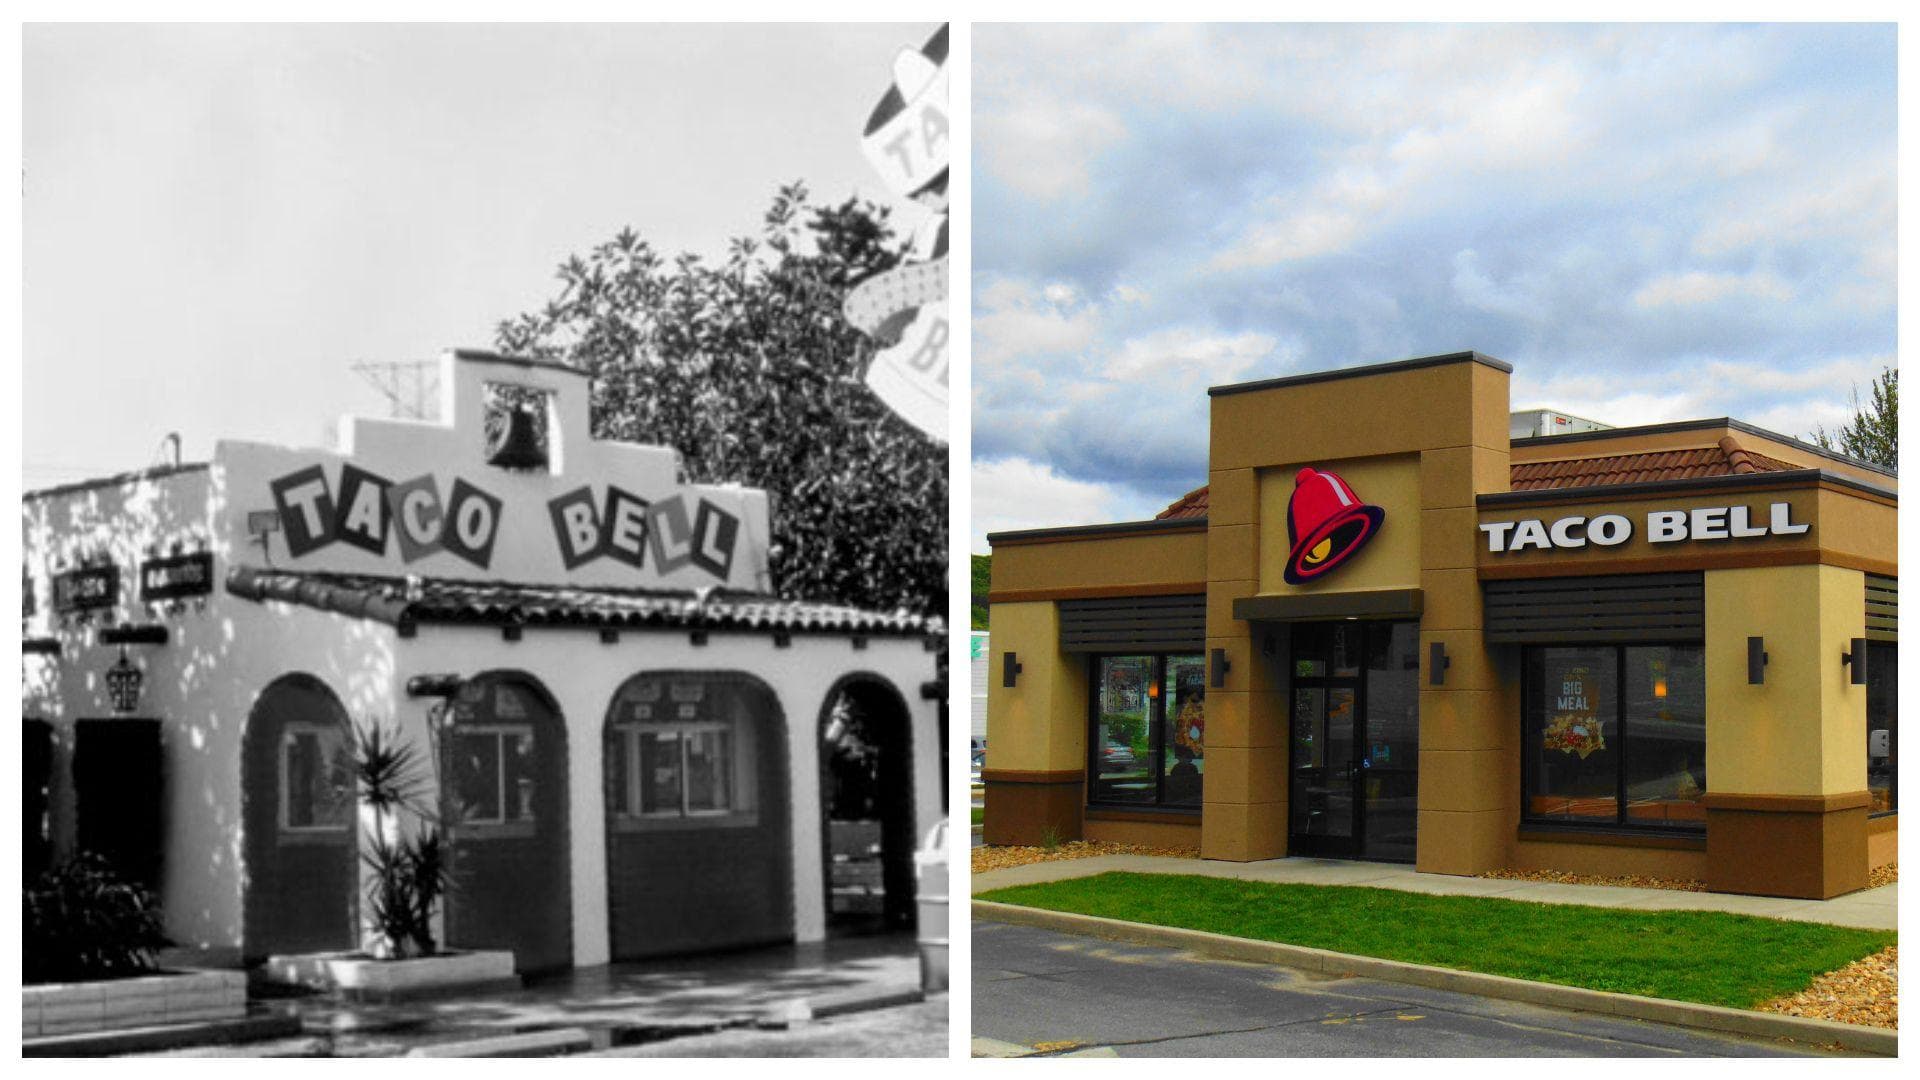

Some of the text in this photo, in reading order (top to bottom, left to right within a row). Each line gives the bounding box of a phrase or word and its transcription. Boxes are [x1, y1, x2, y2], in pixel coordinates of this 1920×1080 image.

[284, 477, 728, 568] TACO BELL
[1479, 502, 1810, 553] TACO BELL
[1557, 696, 1590, 711] MEAL
[1563, 681, 1583, 695] BIG
